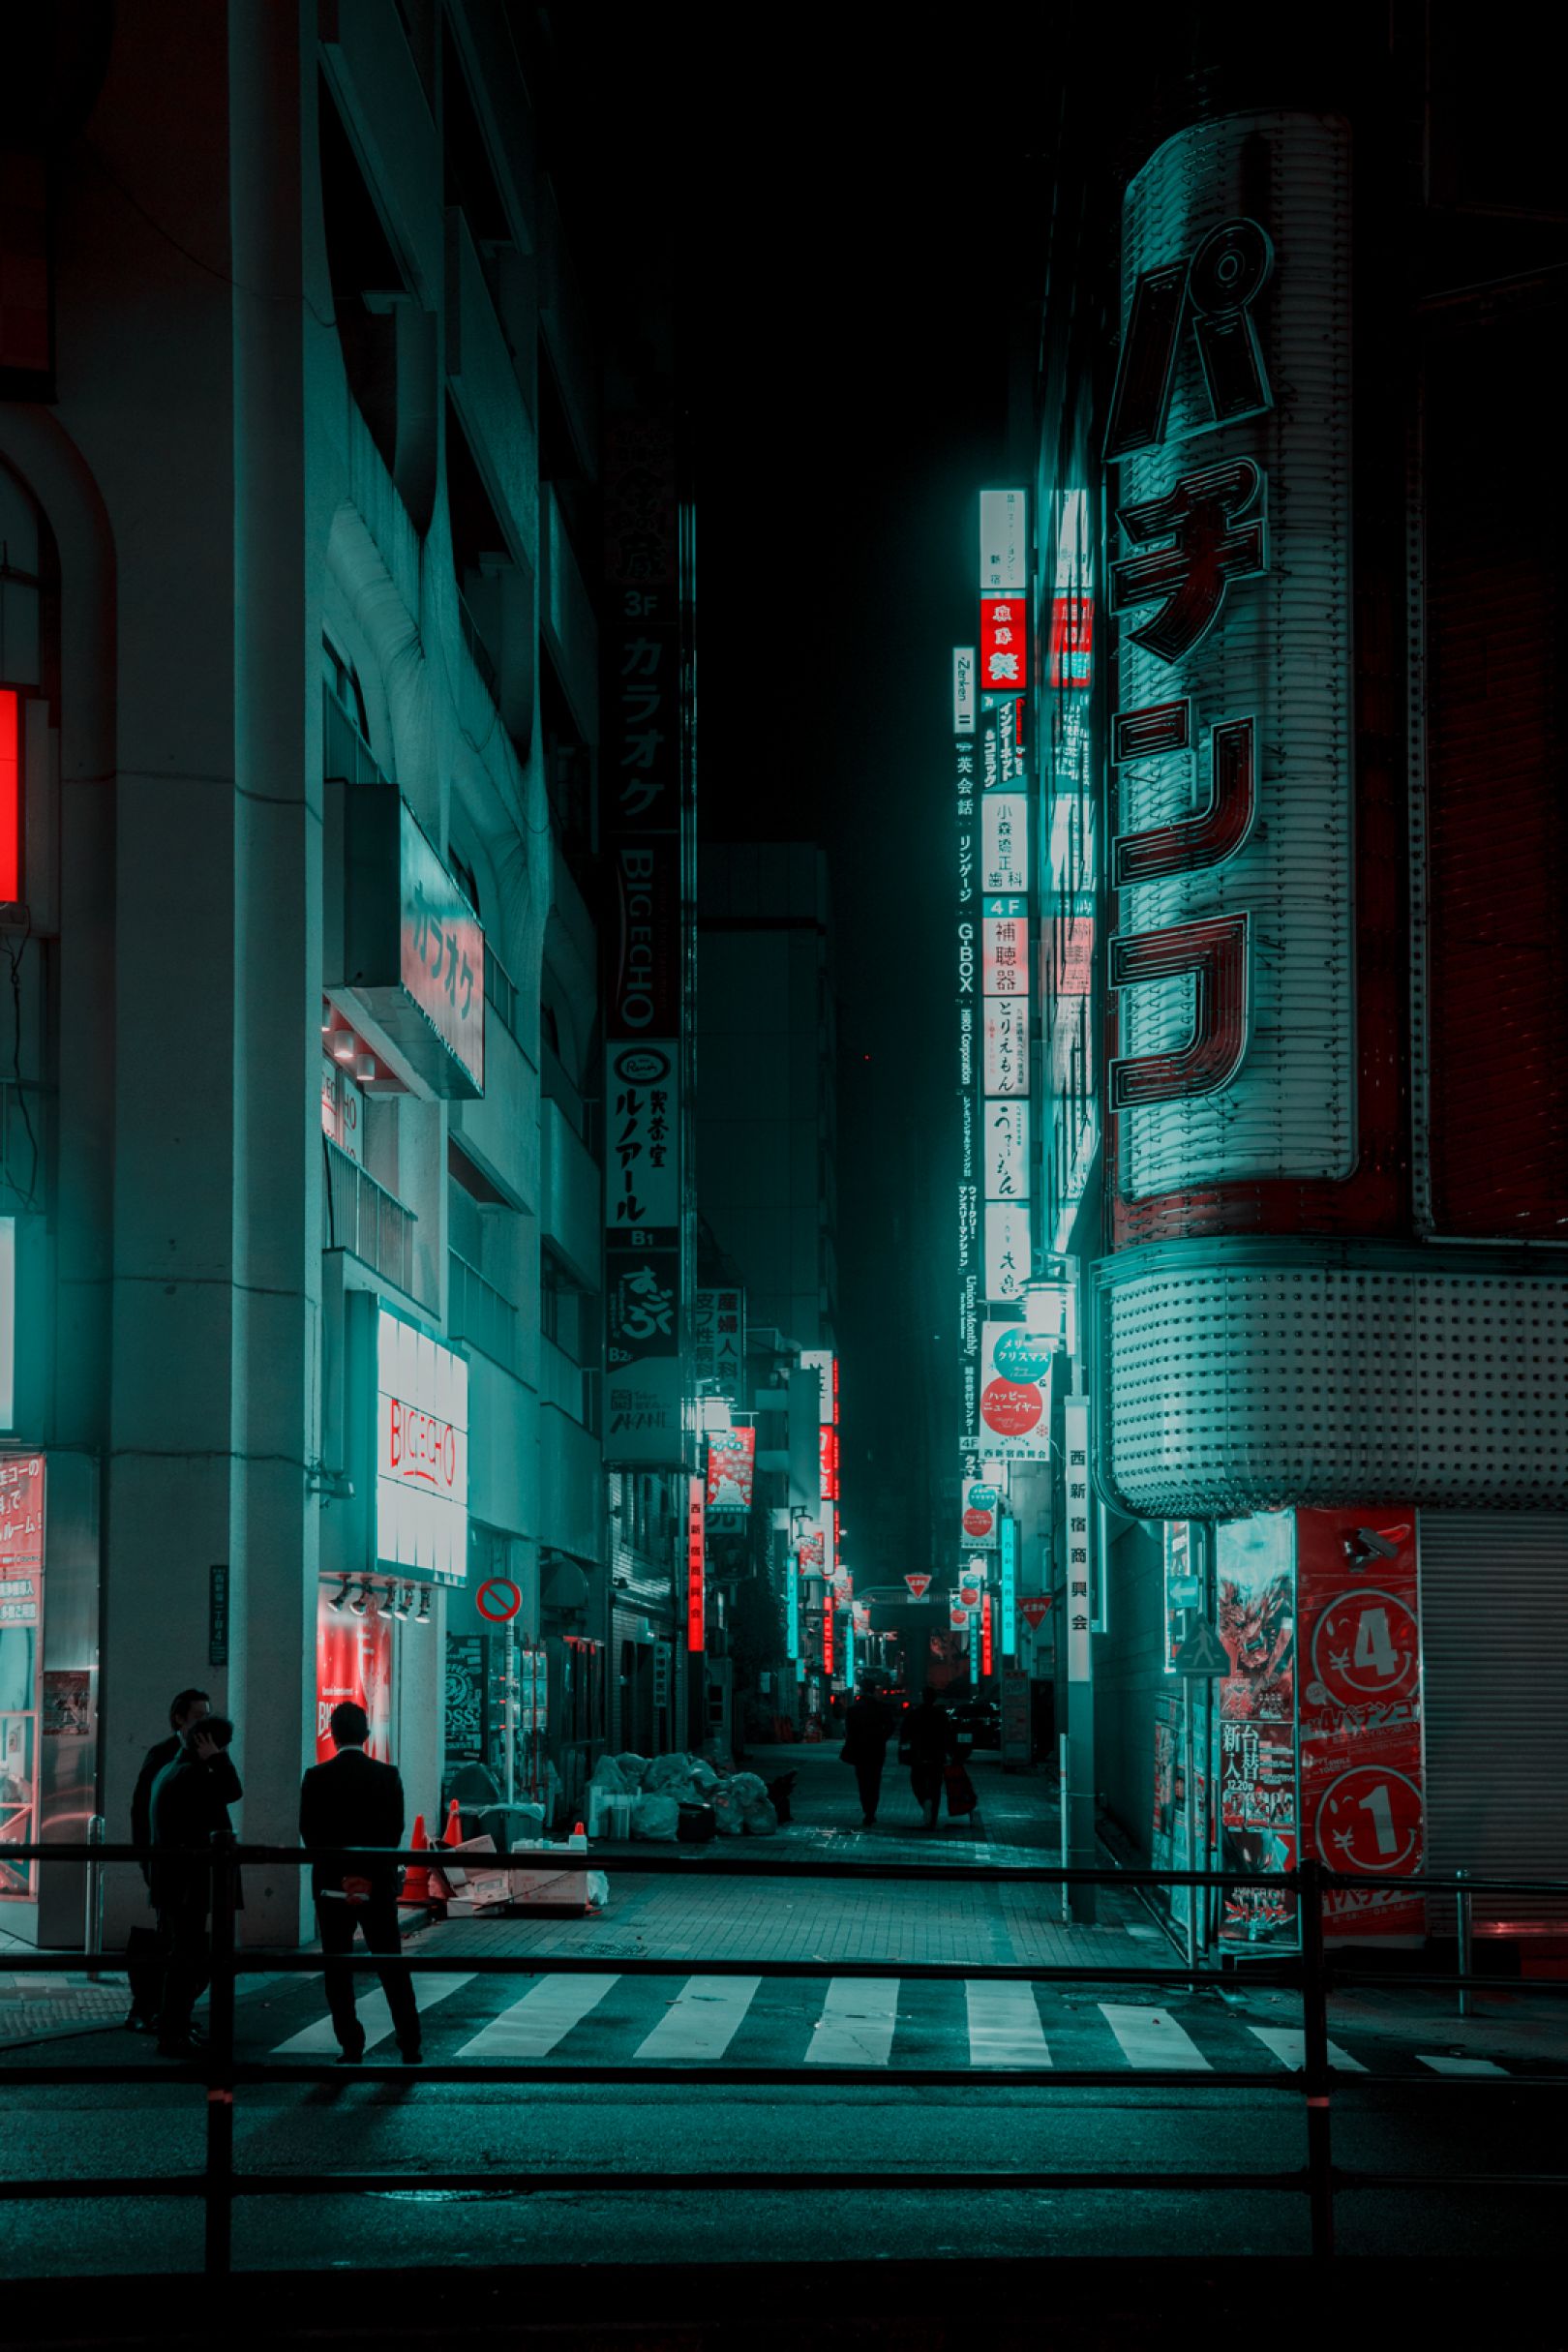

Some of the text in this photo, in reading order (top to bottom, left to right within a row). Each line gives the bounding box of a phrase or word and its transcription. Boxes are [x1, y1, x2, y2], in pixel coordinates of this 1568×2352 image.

[623, 588, 658, 617] 3F
[1101, 216, 1276, 1112] パチンコ
[618, 636, 666, 817] カラオケ
[999, 701, 1013, 782] インターネット
[957, 755, 974, 816] 英会話
[959, 835, 973, 902] リンゲージ
[619, 848, 656, 1030] BIG ECHO
[990, 899, 1020, 916] 4F
[412, 880, 475, 1020] カラオケ
[957, 922, 974, 993] G-BOX
[961, 1008, 973, 1032] HIRO
[998, 1001, 1014, 1092] とりえもん
[958, 1033, 973, 1085] Corporation
[616, 1088, 646, 1222] ルノアール
[647, 1090, 670, 1168] 喫茶室
[631, 1230, 653, 1246] B1
[621, 1265, 675, 1340] すごろく
[717, 1293, 738, 1379] 産婦人科
[963, 1275, 978, 1357] Union Monthly
[998, 1351, 1049, 1363] クリスマス
[983, 1402, 1041, 1413] ニューイヤー
[988, 1391, 1028, 1402] ハッピー
[1070, 1449, 1088, 1631] 西新宿商興会
